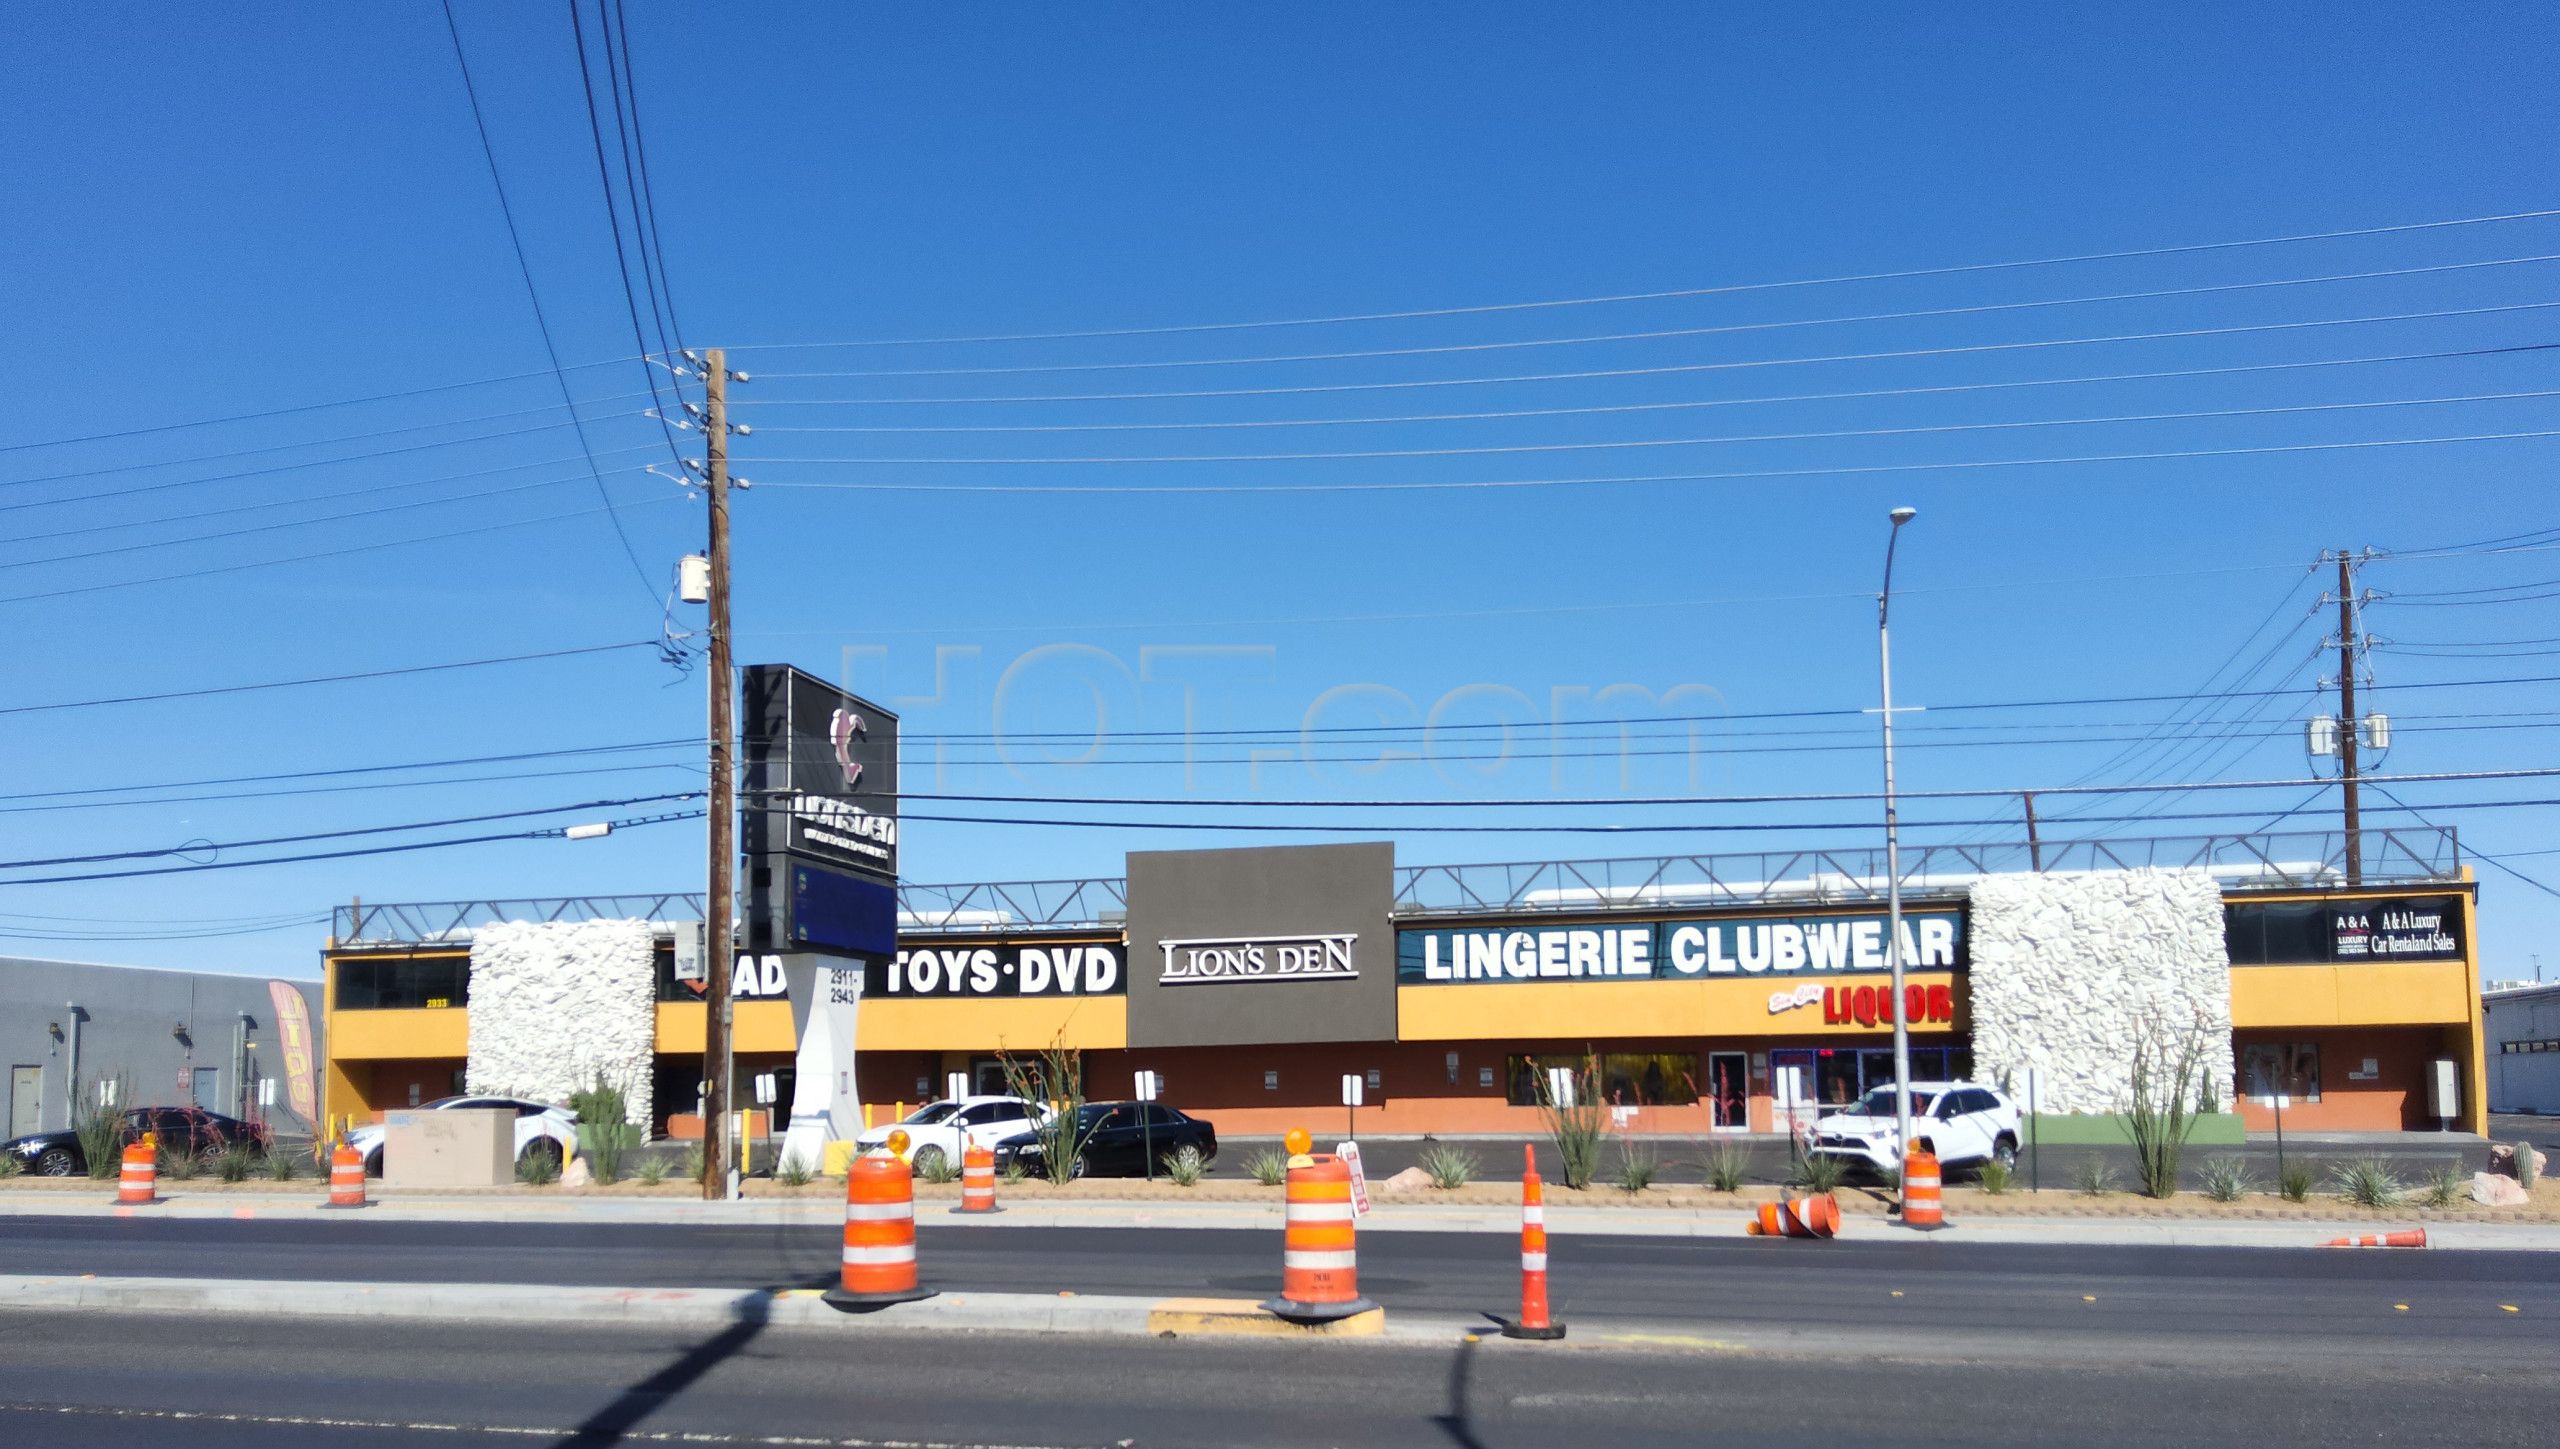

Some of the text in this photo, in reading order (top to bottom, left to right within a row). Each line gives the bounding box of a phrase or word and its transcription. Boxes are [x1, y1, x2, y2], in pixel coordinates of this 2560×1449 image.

[2410, 911, 2441, 934] Luxury
[1425, 918, 1953, 979] LINGERIE CLUBWEAR
[2338, 935, 2369, 944] LUXURY
[2371, 935, 2387, 953] Car
[2433, 932, 2456, 951] Sales
[1161, 938, 1354, 976] LION'S DEN
[831, 987, 854, 1004] 2943
[1823, 983, 1953, 1028] LIQUOR
